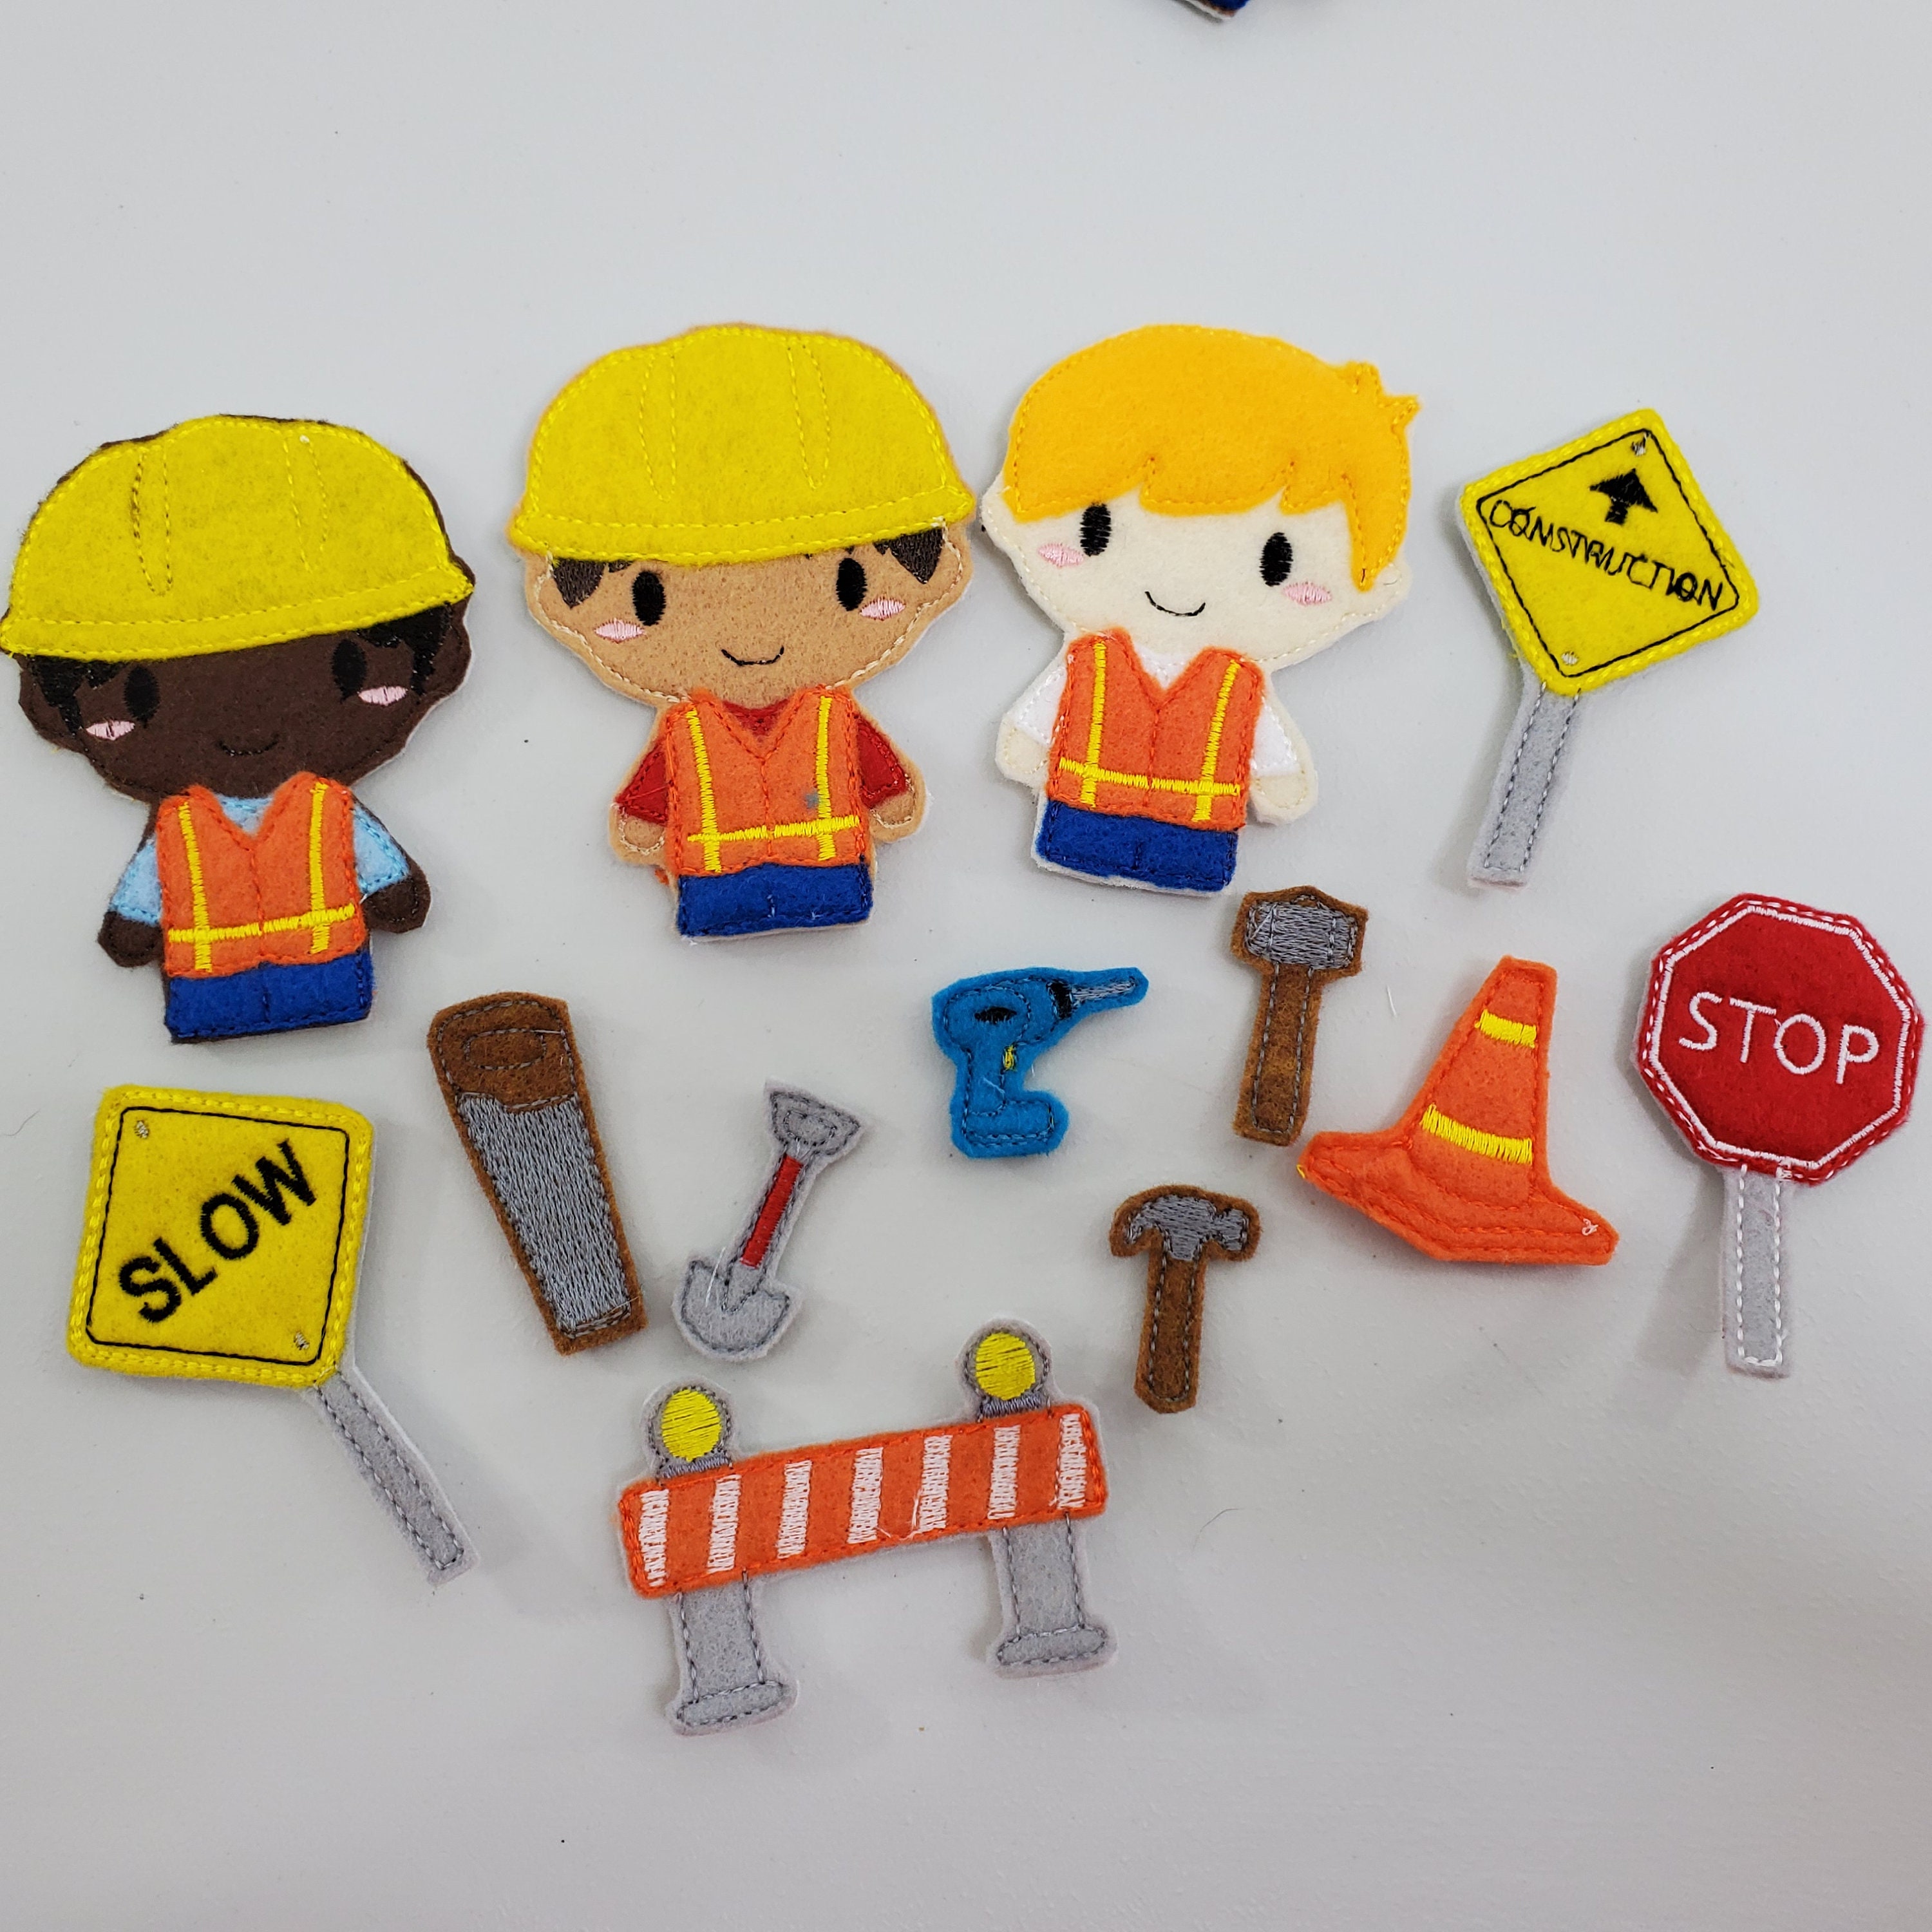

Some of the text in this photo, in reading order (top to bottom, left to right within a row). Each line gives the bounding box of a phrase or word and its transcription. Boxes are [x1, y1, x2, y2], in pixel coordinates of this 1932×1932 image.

[1488, 499, 1723, 611] CONSTRUCTION
[1678, 991, 1880, 1084] STOP
[117, 1137, 317, 1323] SLOW
